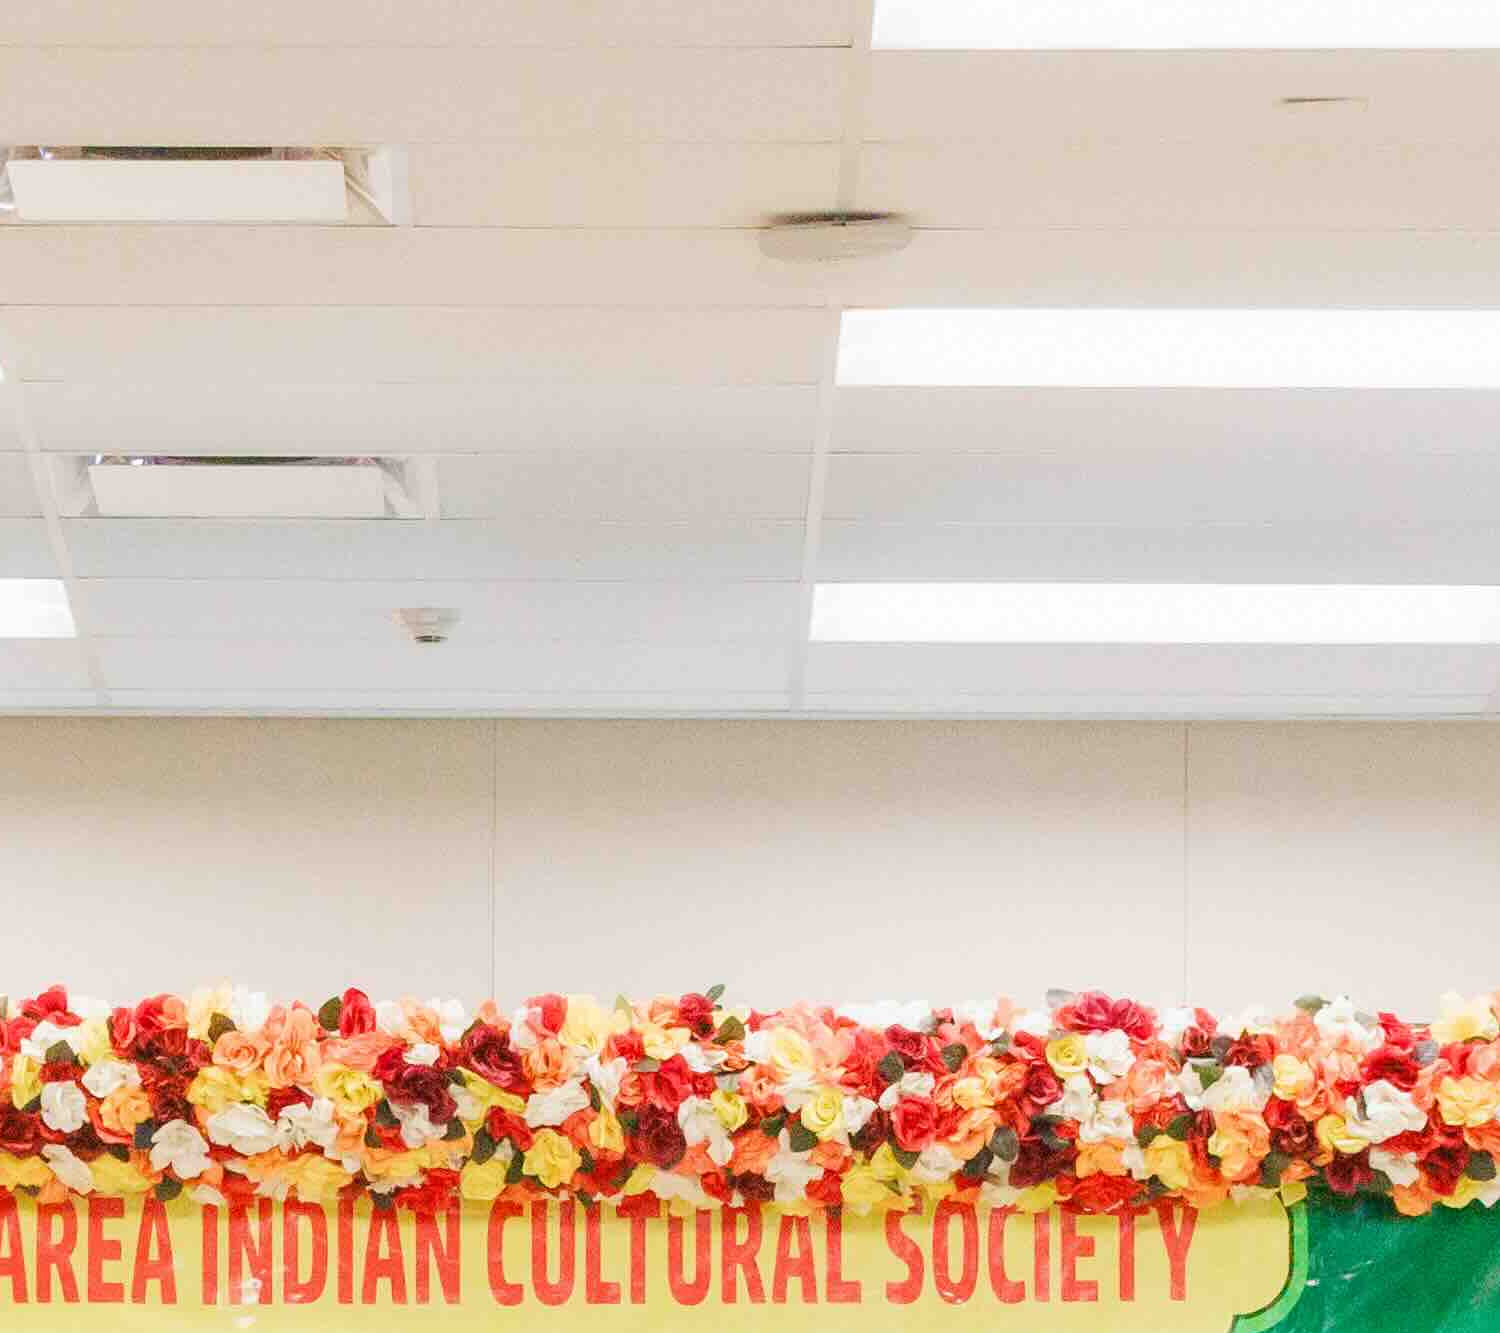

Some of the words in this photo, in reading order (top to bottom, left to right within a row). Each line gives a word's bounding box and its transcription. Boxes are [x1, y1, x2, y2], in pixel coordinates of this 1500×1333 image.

[201, 1196, 462, 1305] INDIAN
[487, 1200, 862, 1307] CULTURAL
[885, 1200, 1198, 1304] SOCIETY
